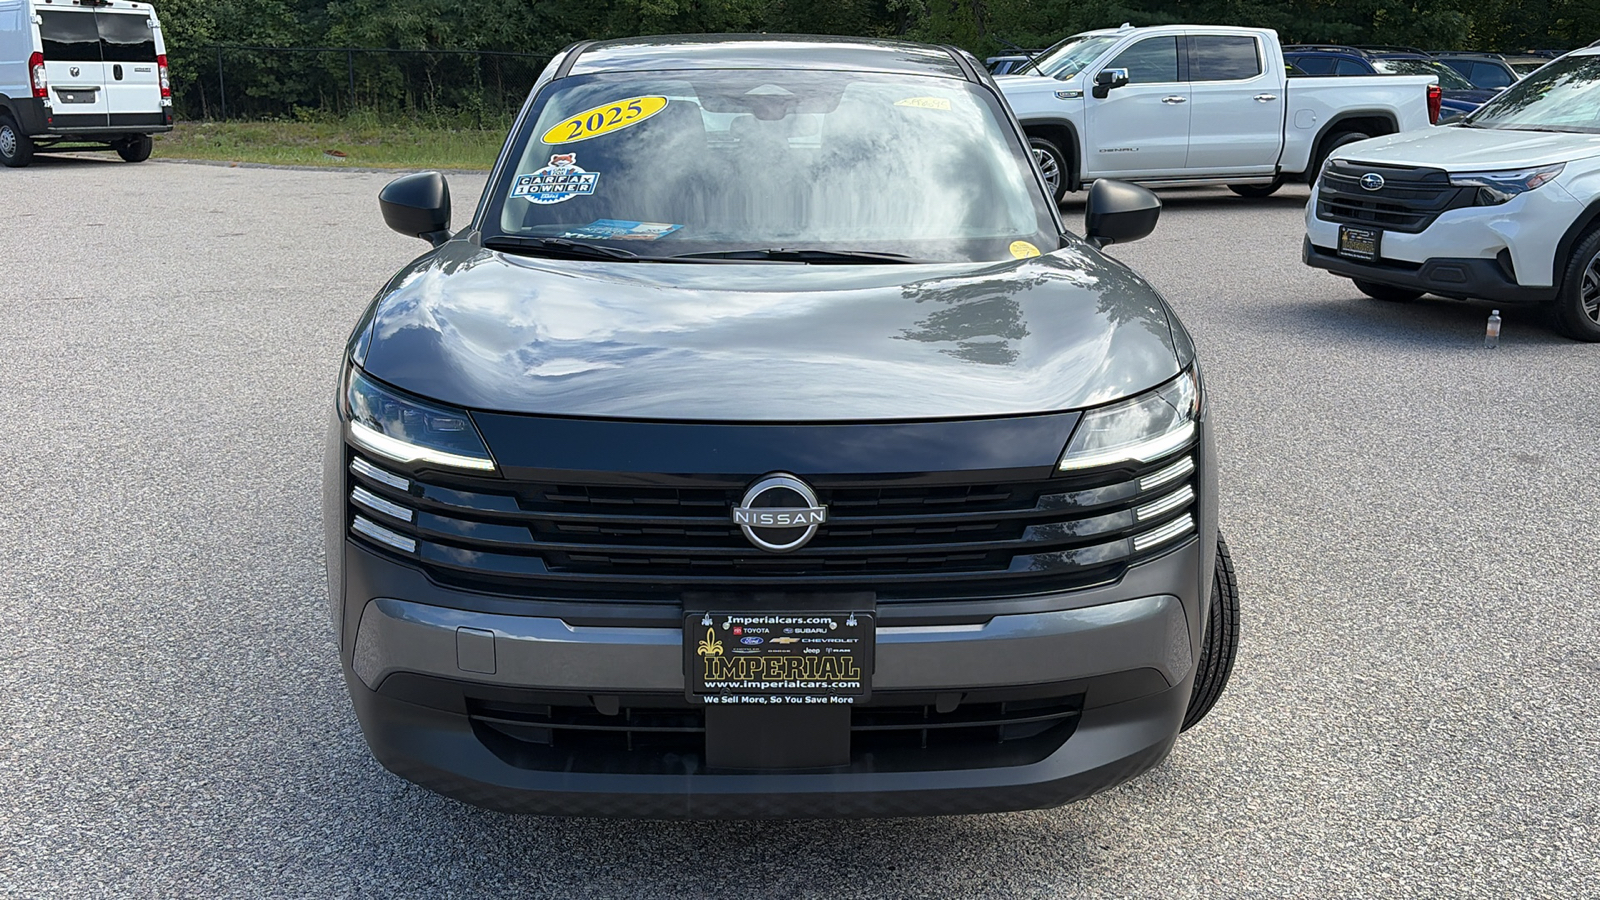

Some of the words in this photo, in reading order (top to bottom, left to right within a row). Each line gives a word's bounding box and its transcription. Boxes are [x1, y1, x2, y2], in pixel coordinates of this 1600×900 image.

[566, 99, 642, 140] 2025
[521, 176, 591, 185] CARFAX
[529, 184, 589, 193] OWNER
[735, 510, 823, 525] NISSAN
[727, 615, 832, 626] Imperialcars.com
[704, 656, 861, 680] IMPERIAL
[704, 680, 860, 689] www.imperialcars.com
[703, 695, 719, 704] We
[721, 695, 739, 704] Sell
[741, 695, 768, 705] More,
[770, 695, 783, 704] So
[785, 695, 803, 704] You
[805, 695, 828, 704] Save
[830, 695, 854, 704] More
